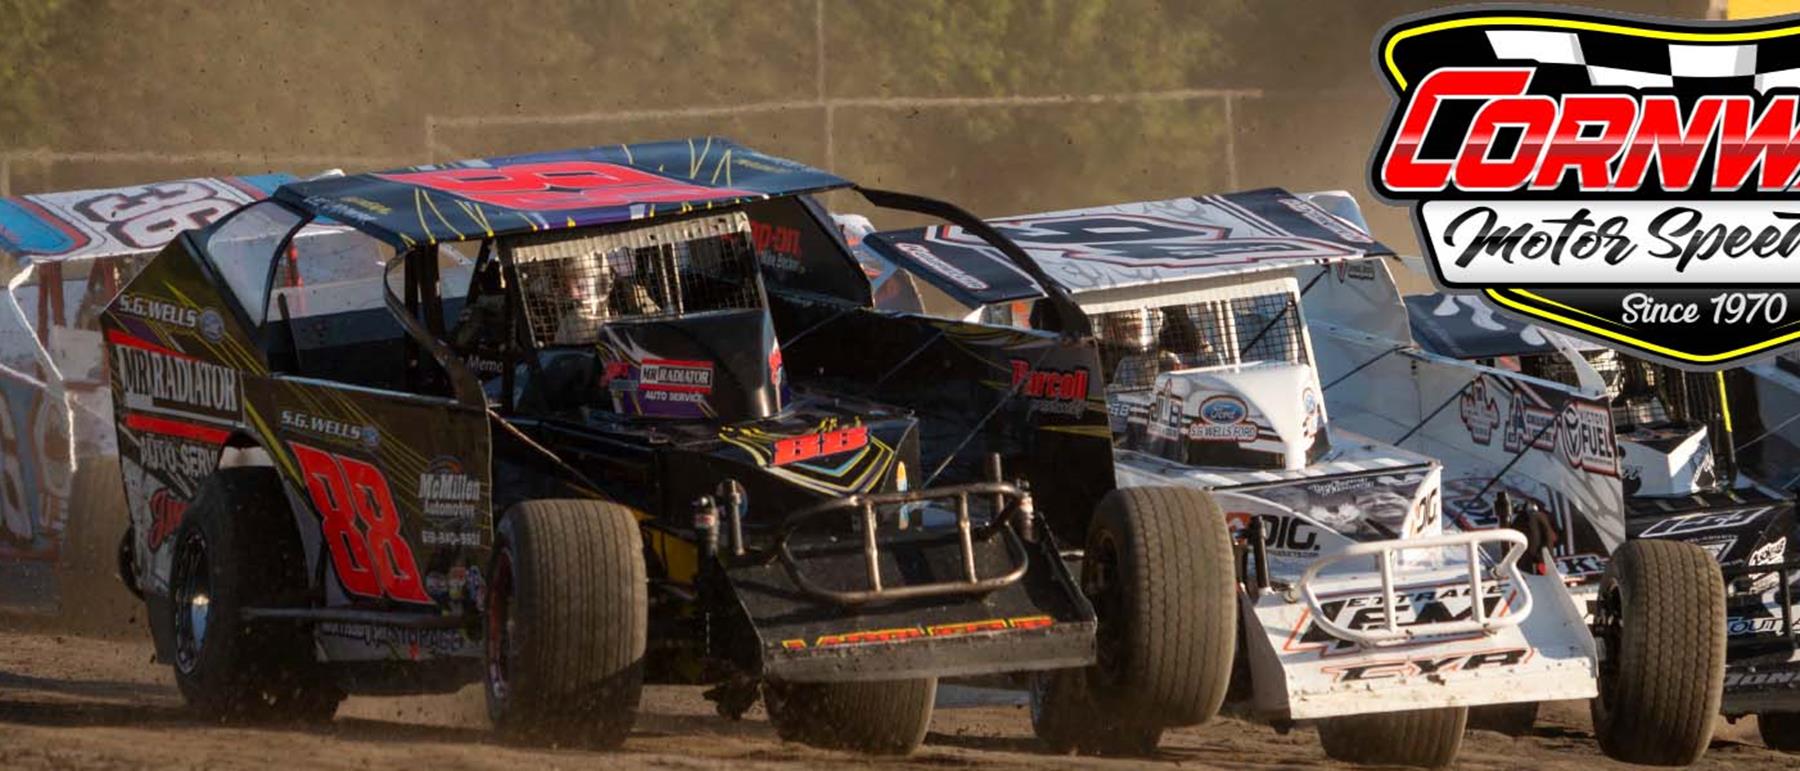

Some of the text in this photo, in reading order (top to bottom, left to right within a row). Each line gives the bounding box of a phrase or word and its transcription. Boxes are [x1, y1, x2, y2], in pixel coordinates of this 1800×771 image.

[149, 301, 198, 328] WELLS
[149, 352, 238, 412] RADIATOR
[659, 367, 709, 384] RADIATOR
[645, 390, 705, 402] AUTO SERVICE
[313, 417, 360, 440] WELLS
[1582, 422, 1614, 459] FUEL
[286, 440, 436, 606] 88
